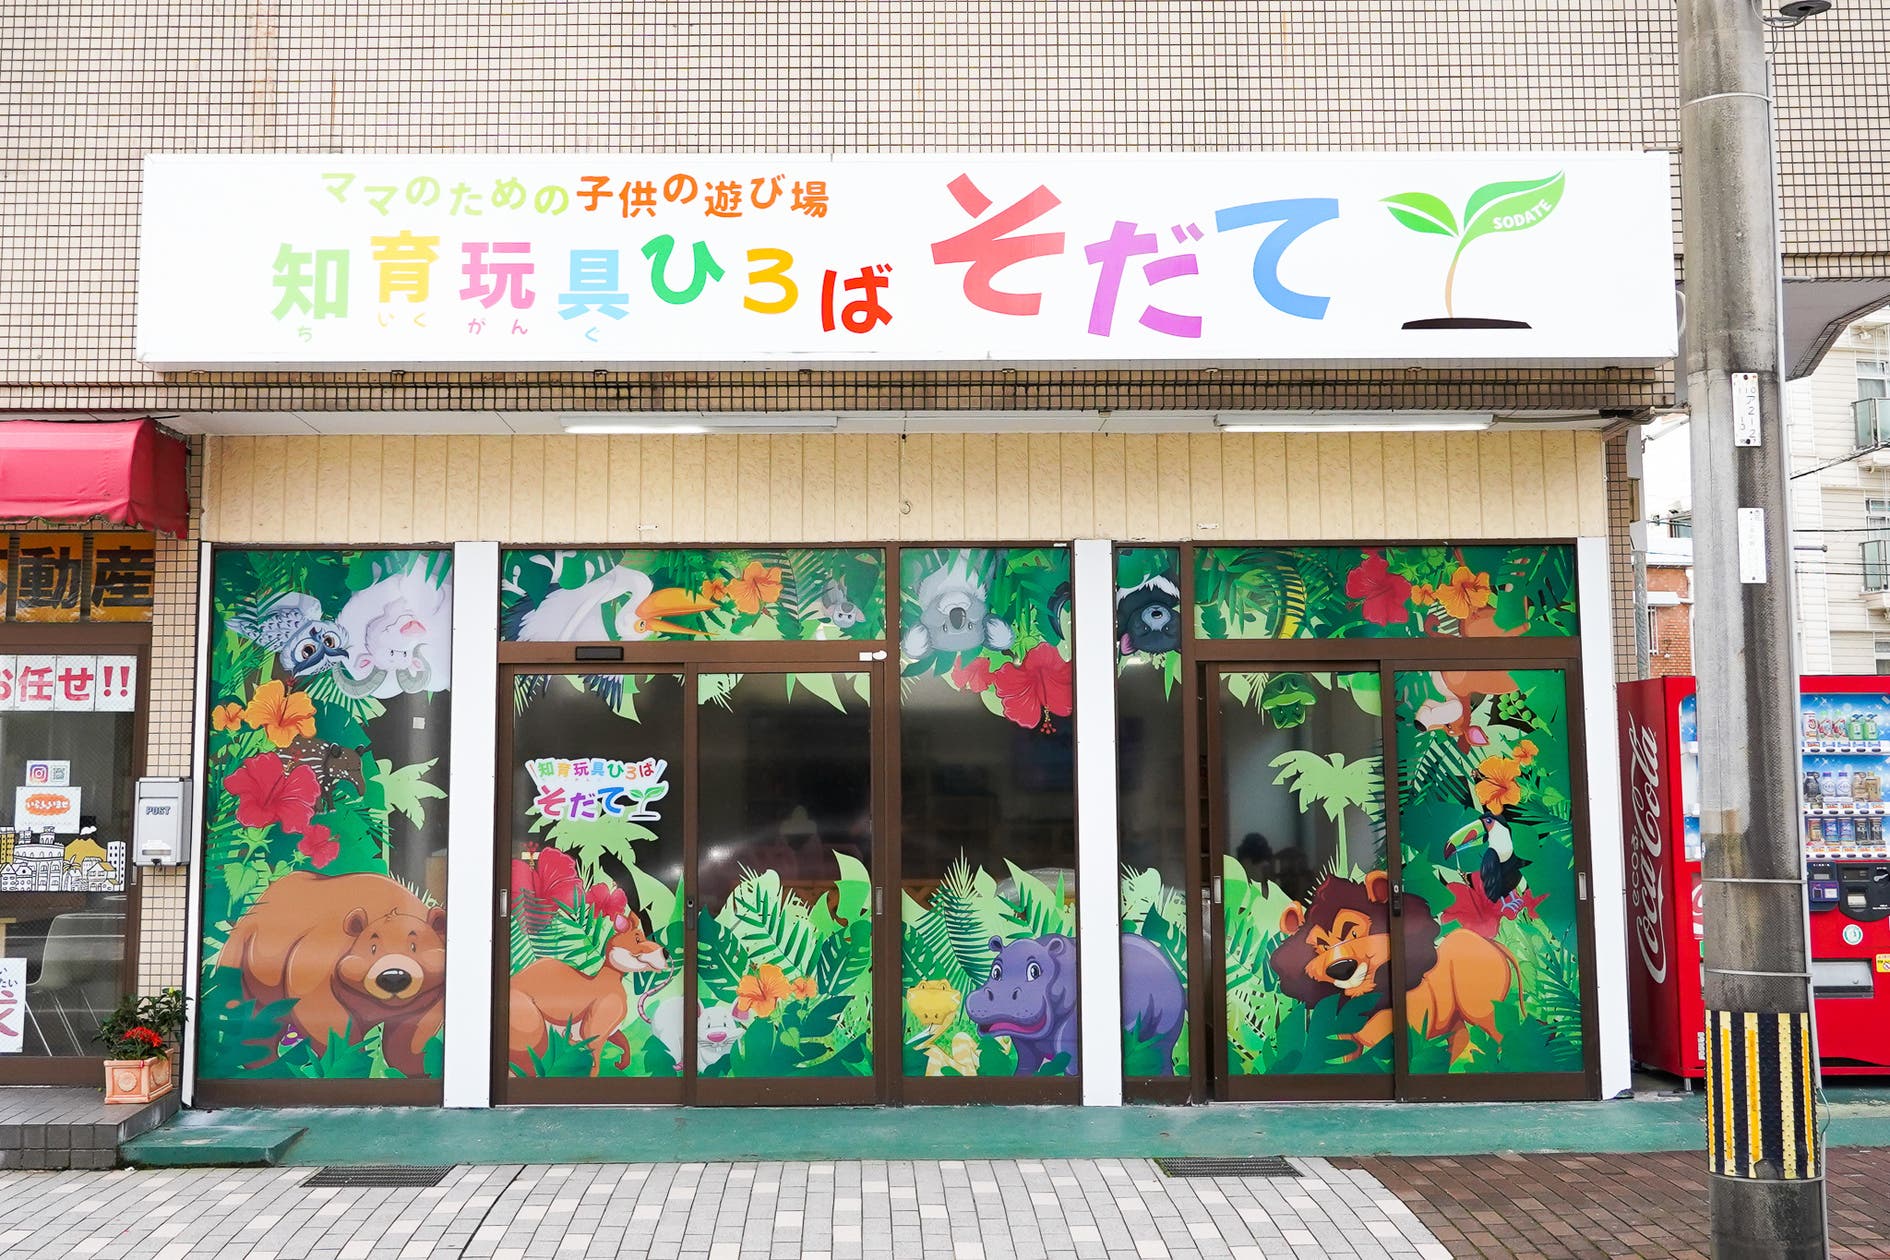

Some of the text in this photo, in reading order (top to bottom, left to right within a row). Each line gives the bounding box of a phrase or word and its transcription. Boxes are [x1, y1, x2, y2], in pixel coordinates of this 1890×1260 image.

[320, 172, 831, 220] ママのための子供の遊び場
[1493, 198, 1553, 230] SODATE
[271, 172, 1341, 338] 知育玩具ひろば そだて
[298, 325, 313, 342] ち
[467, 318, 529, 336] がん
[0, 545, 153, 609] 動産
[537, 760, 655, 781] 知育玩具ひろば
[146, 806, 171, 816] POST
[537, 785, 625, 818] そだて
[1629, 711, 1667, 984] Coca-Cola
